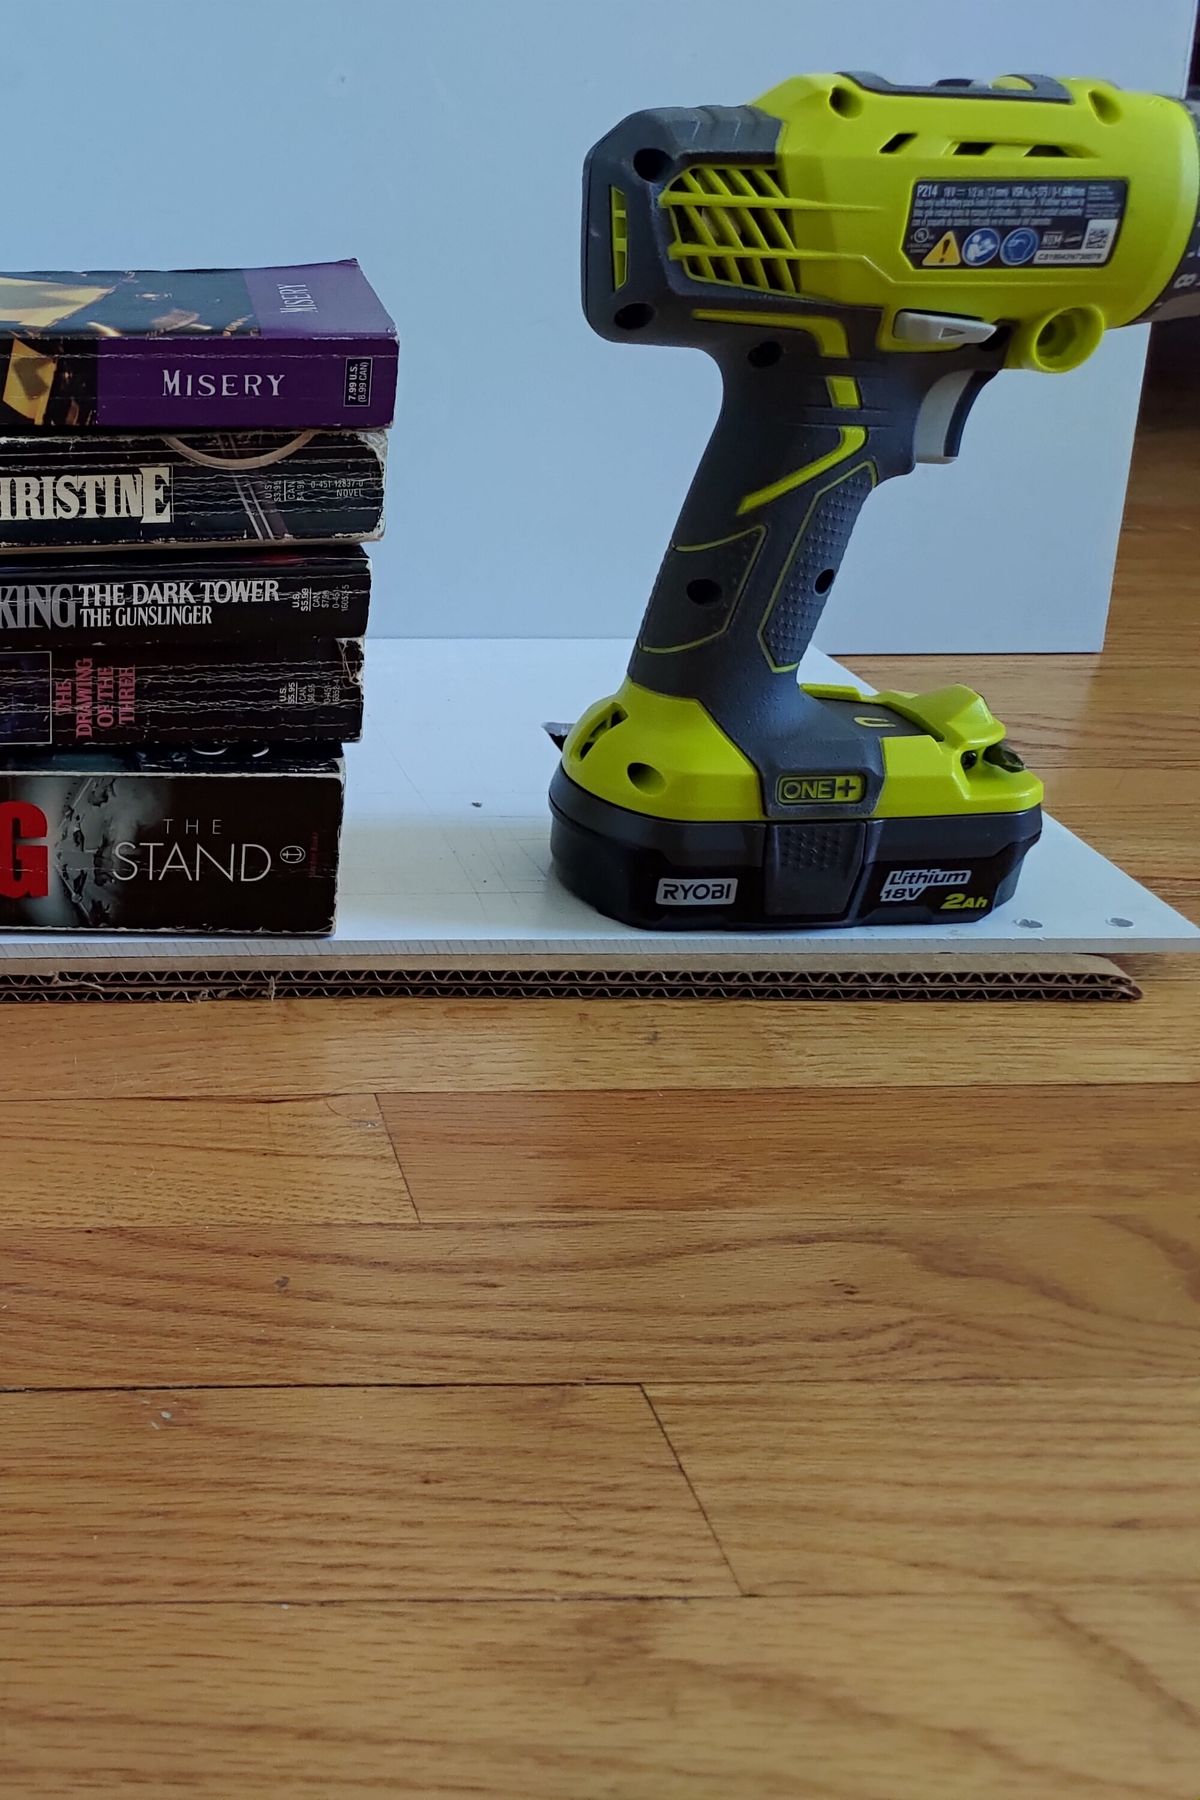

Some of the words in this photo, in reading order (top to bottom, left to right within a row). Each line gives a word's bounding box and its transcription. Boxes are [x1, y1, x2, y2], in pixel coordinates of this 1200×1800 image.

[917, 185, 938, 198] P214
[277, 284, 318, 314] MISERY
[349, 363, 358, 380] U.S.
[358, 362, 369, 381] CAN)
[162, 369, 286, 397] MISERY
[349, 381, 358, 401] 7.99
[358, 382, 369, 403] (8.99
[336, 488, 362, 497] NOVEL
[79, 584, 126, 607] THE
[132, 582, 196, 606] DARK
[200, 580, 280, 603] TOWER
[80, 607, 112, 627] THE
[115, 605, 213, 627] GUNSLINGER
[97, 666, 114, 700] THE
[55, 680, 72, 716] THE
[75, 658, 93, 739] DRAWING
[118, 664, 135, 725] THREE
[97, 704, 114, 728] OF
[163, 818, 222, 835] THE
[112, 841, 272, 882] STAND
[889, 869, 969, 886] Lithium
[663, 882, 732, 901] RYOBI
[883, 886, 922, 901] 18V
[940, 893, 988, 910] 2Ah
